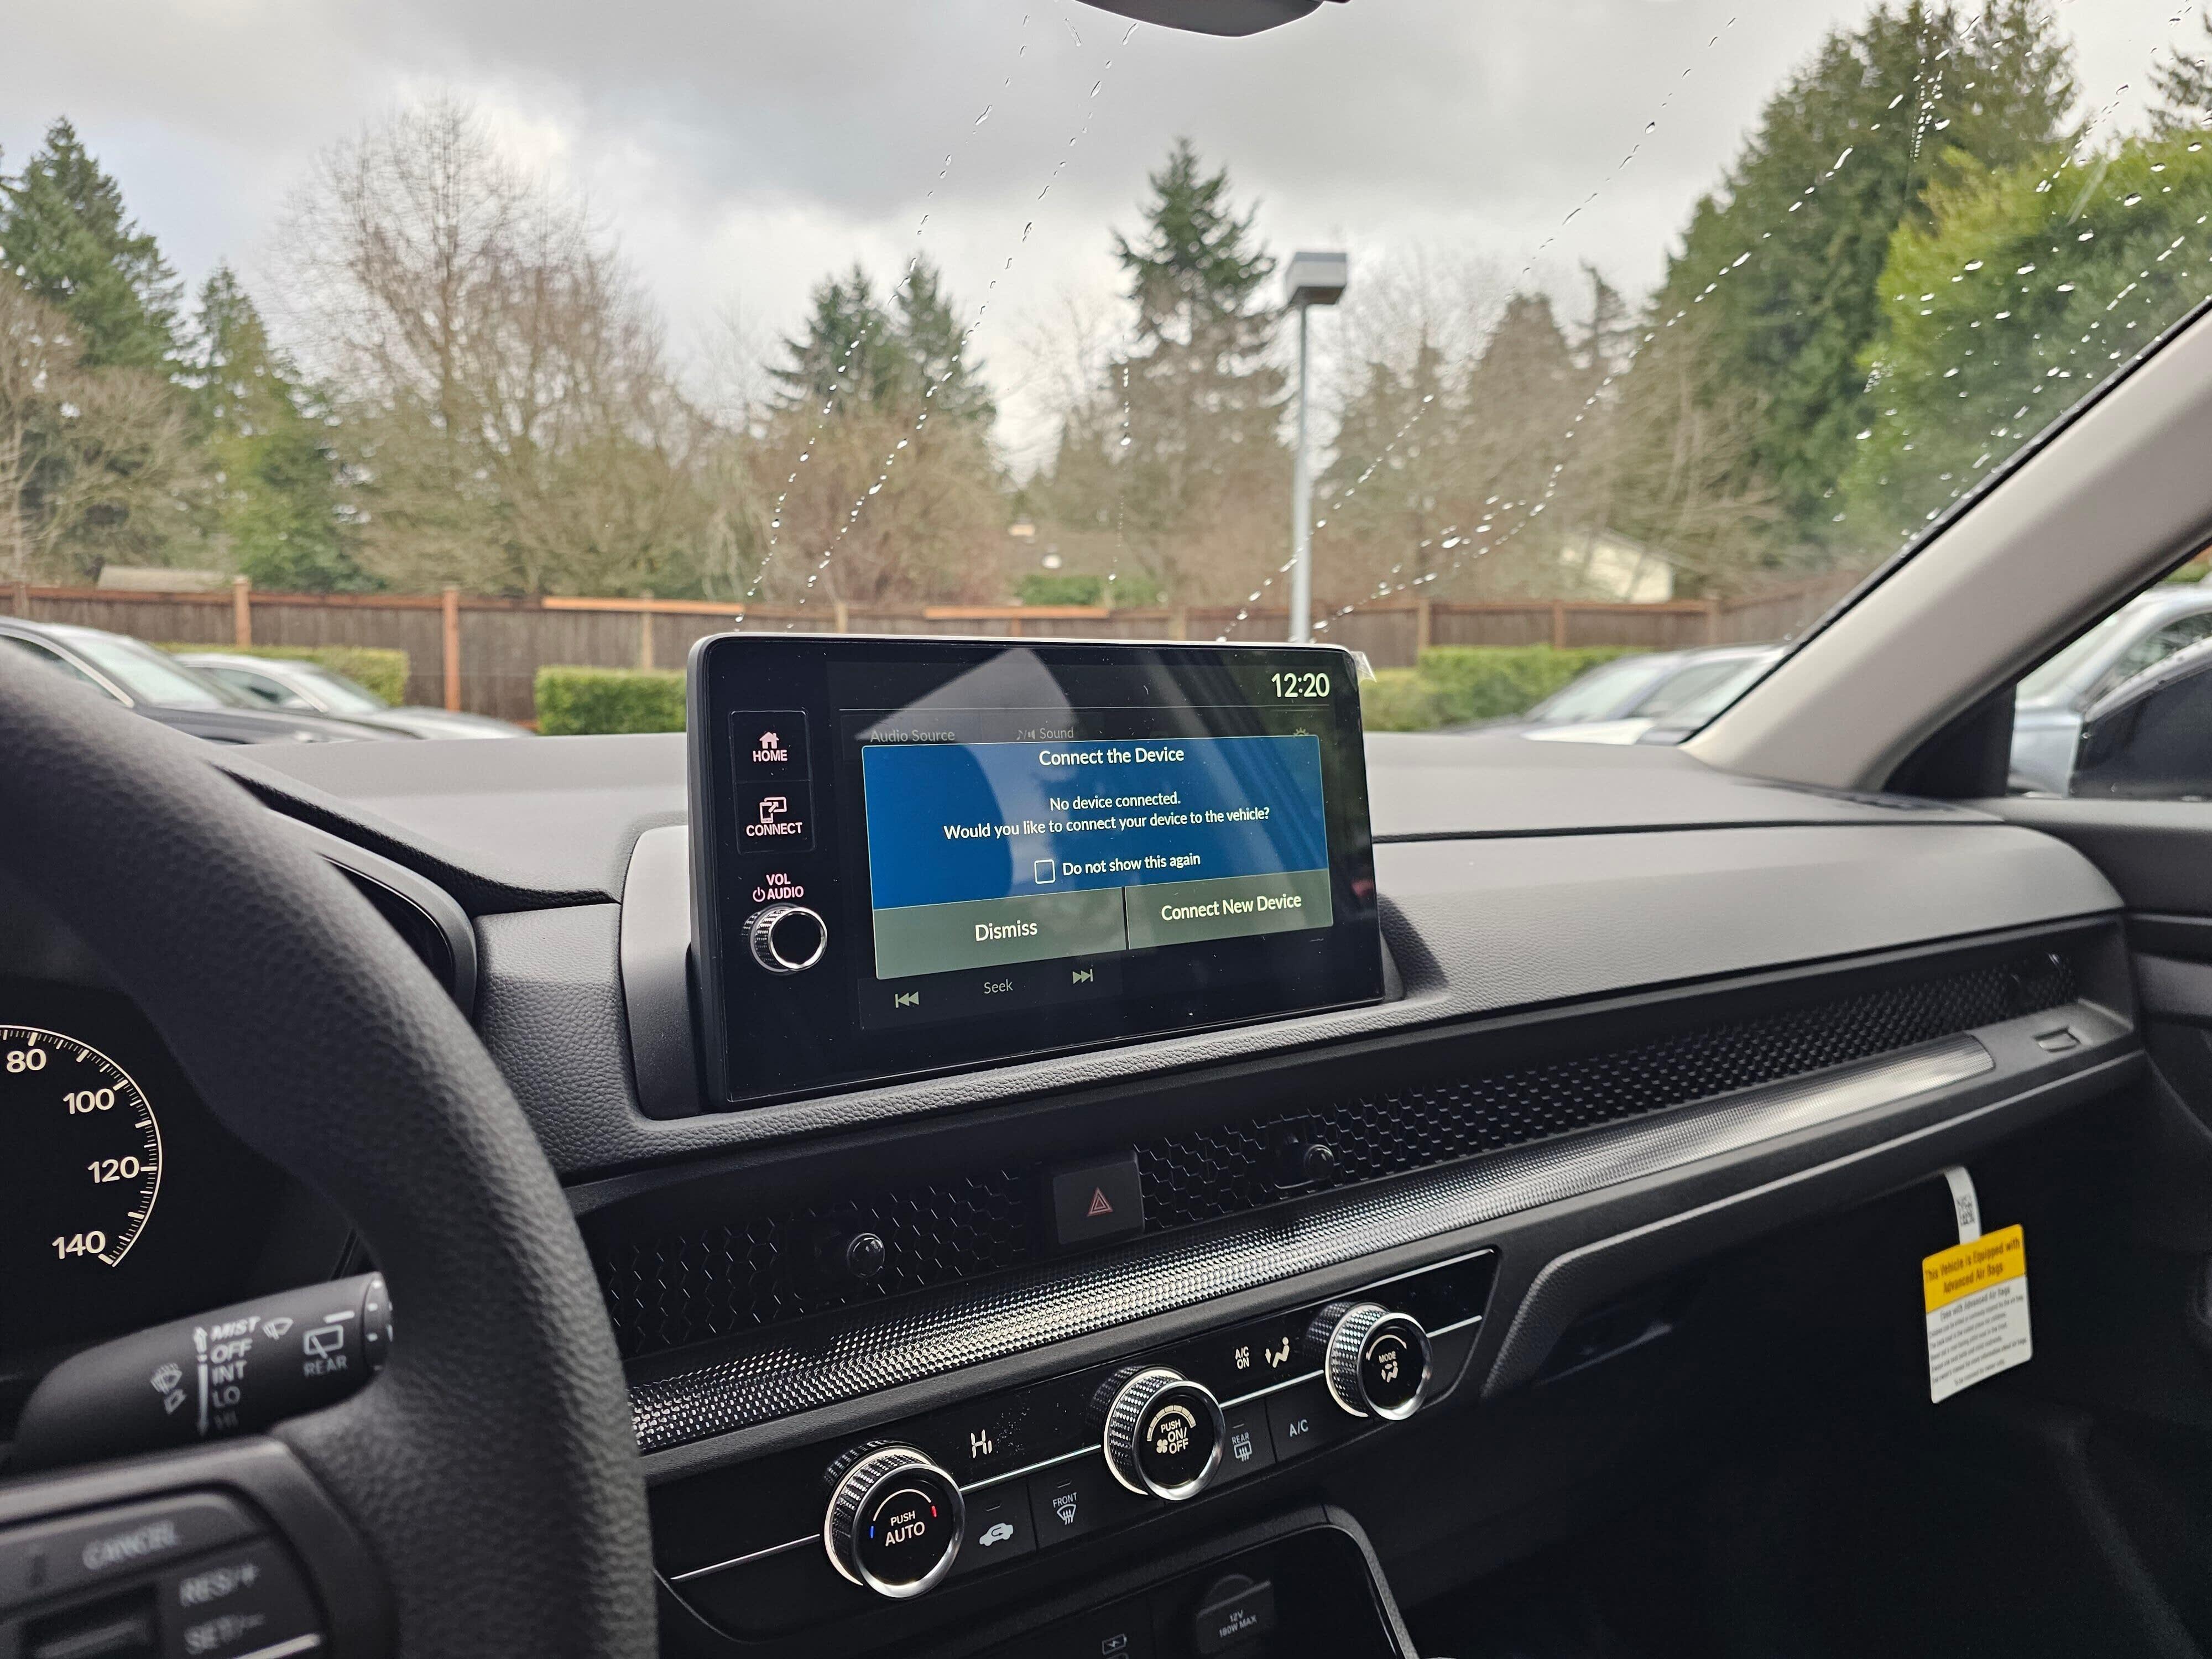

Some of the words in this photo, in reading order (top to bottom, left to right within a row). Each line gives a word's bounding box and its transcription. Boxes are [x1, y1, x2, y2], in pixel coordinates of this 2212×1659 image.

[1272, 672, 1330, 698] 12:20
[870, 730, 908, 743] Audio
[912, 729, 956, 742] Source
[1040, 727, 1074, 739] Sound
[753, 749, 787, 762] HOME
[1039, 750, 1104, 766] Connect
[1107, 748, 1131, 764] the
[1135, 747, 1185, 763] Device
[1050, 797, 1070, 811] No
[1073, 795, 1113, 810] device
[1115, 791, 1181, 808] connected.
[746, 822, 803, 837] CONNECT
[943, 823, 991, 839] Would
[994, 825, 1020, 839] you
[1023, 820, 1046, 835] like
[1048, 821, 1063, 833] to
[1066, 815, 1117, 832] connect
[1119, 815, 1147, 831] your
[1150, 812, 1188, 827] device
[1190, 812, 1203, 825] to
[1204, 809, 1224, 823] the
[1226, 806, 1270, 822] vehicle?
[1062, 862, 1082, 876] Do
[1084, 860, 1107, 874] not
[1109, 857, 1142, 873] show
[1144, 854, 1167, 869] this
[1169, 852, 1201, 869] again
[766, 873, 791, 886] VOL
[767, 885, 804, 900] AUDIO
[1161, 901, 1220, 922] Connect
[1222, 898, 1254, 916] New
[1256, 893, 1302, 912] Device
[974, 920, 1038, 942] Dismiss
[984, 978, 1013, 995] Seek
[7, 1048, 46, 1073] 80
[63, 1088, 115, 1114] 100
[87, 1156, 139, 1183] 120
[52, 1230, 106, 1259] 140
[1940, 1258, 1964, 1276] Vehicle
[1965, 1254, 1971, 1266] is
[1973, 1242, 2004, 1263] Equipped
[2006, 1237, 2020, 1252] with
[1943, 1271, 1974, 1293] Advanced
[1976, 1268, 1985, 1281] Air
[211, 1316, 261, 1341] MIST
[211, 1338, 253, 1364] OFF
[1235, 1346, 1249, 1360] A/C
[1379, 1351, 1396, 1364] MODE
[212, 1360, 247, 1385] INT
[304, 1354, 348, 1377] REAR
[1237, 1358, 1250, 1370] ON
[212, 1385, 241, 1408] LO
[1161, 1418, 1181, 1433] PUSH
[1167, 1427, 1187, 1443] ON/
[1290, 1419, 1309, 1437] A/C
[1169, 1438, 1189, 1454] OFF
[1232, 1431, 1250, 1445] REAR
[1052, 1491, 1077, 1508] FRONT
[890, 1510, 916, 1526] PUSH
[885, 1522, 925, 1547] AUTO
[1239, 1614, 1258, 1629] MAX
